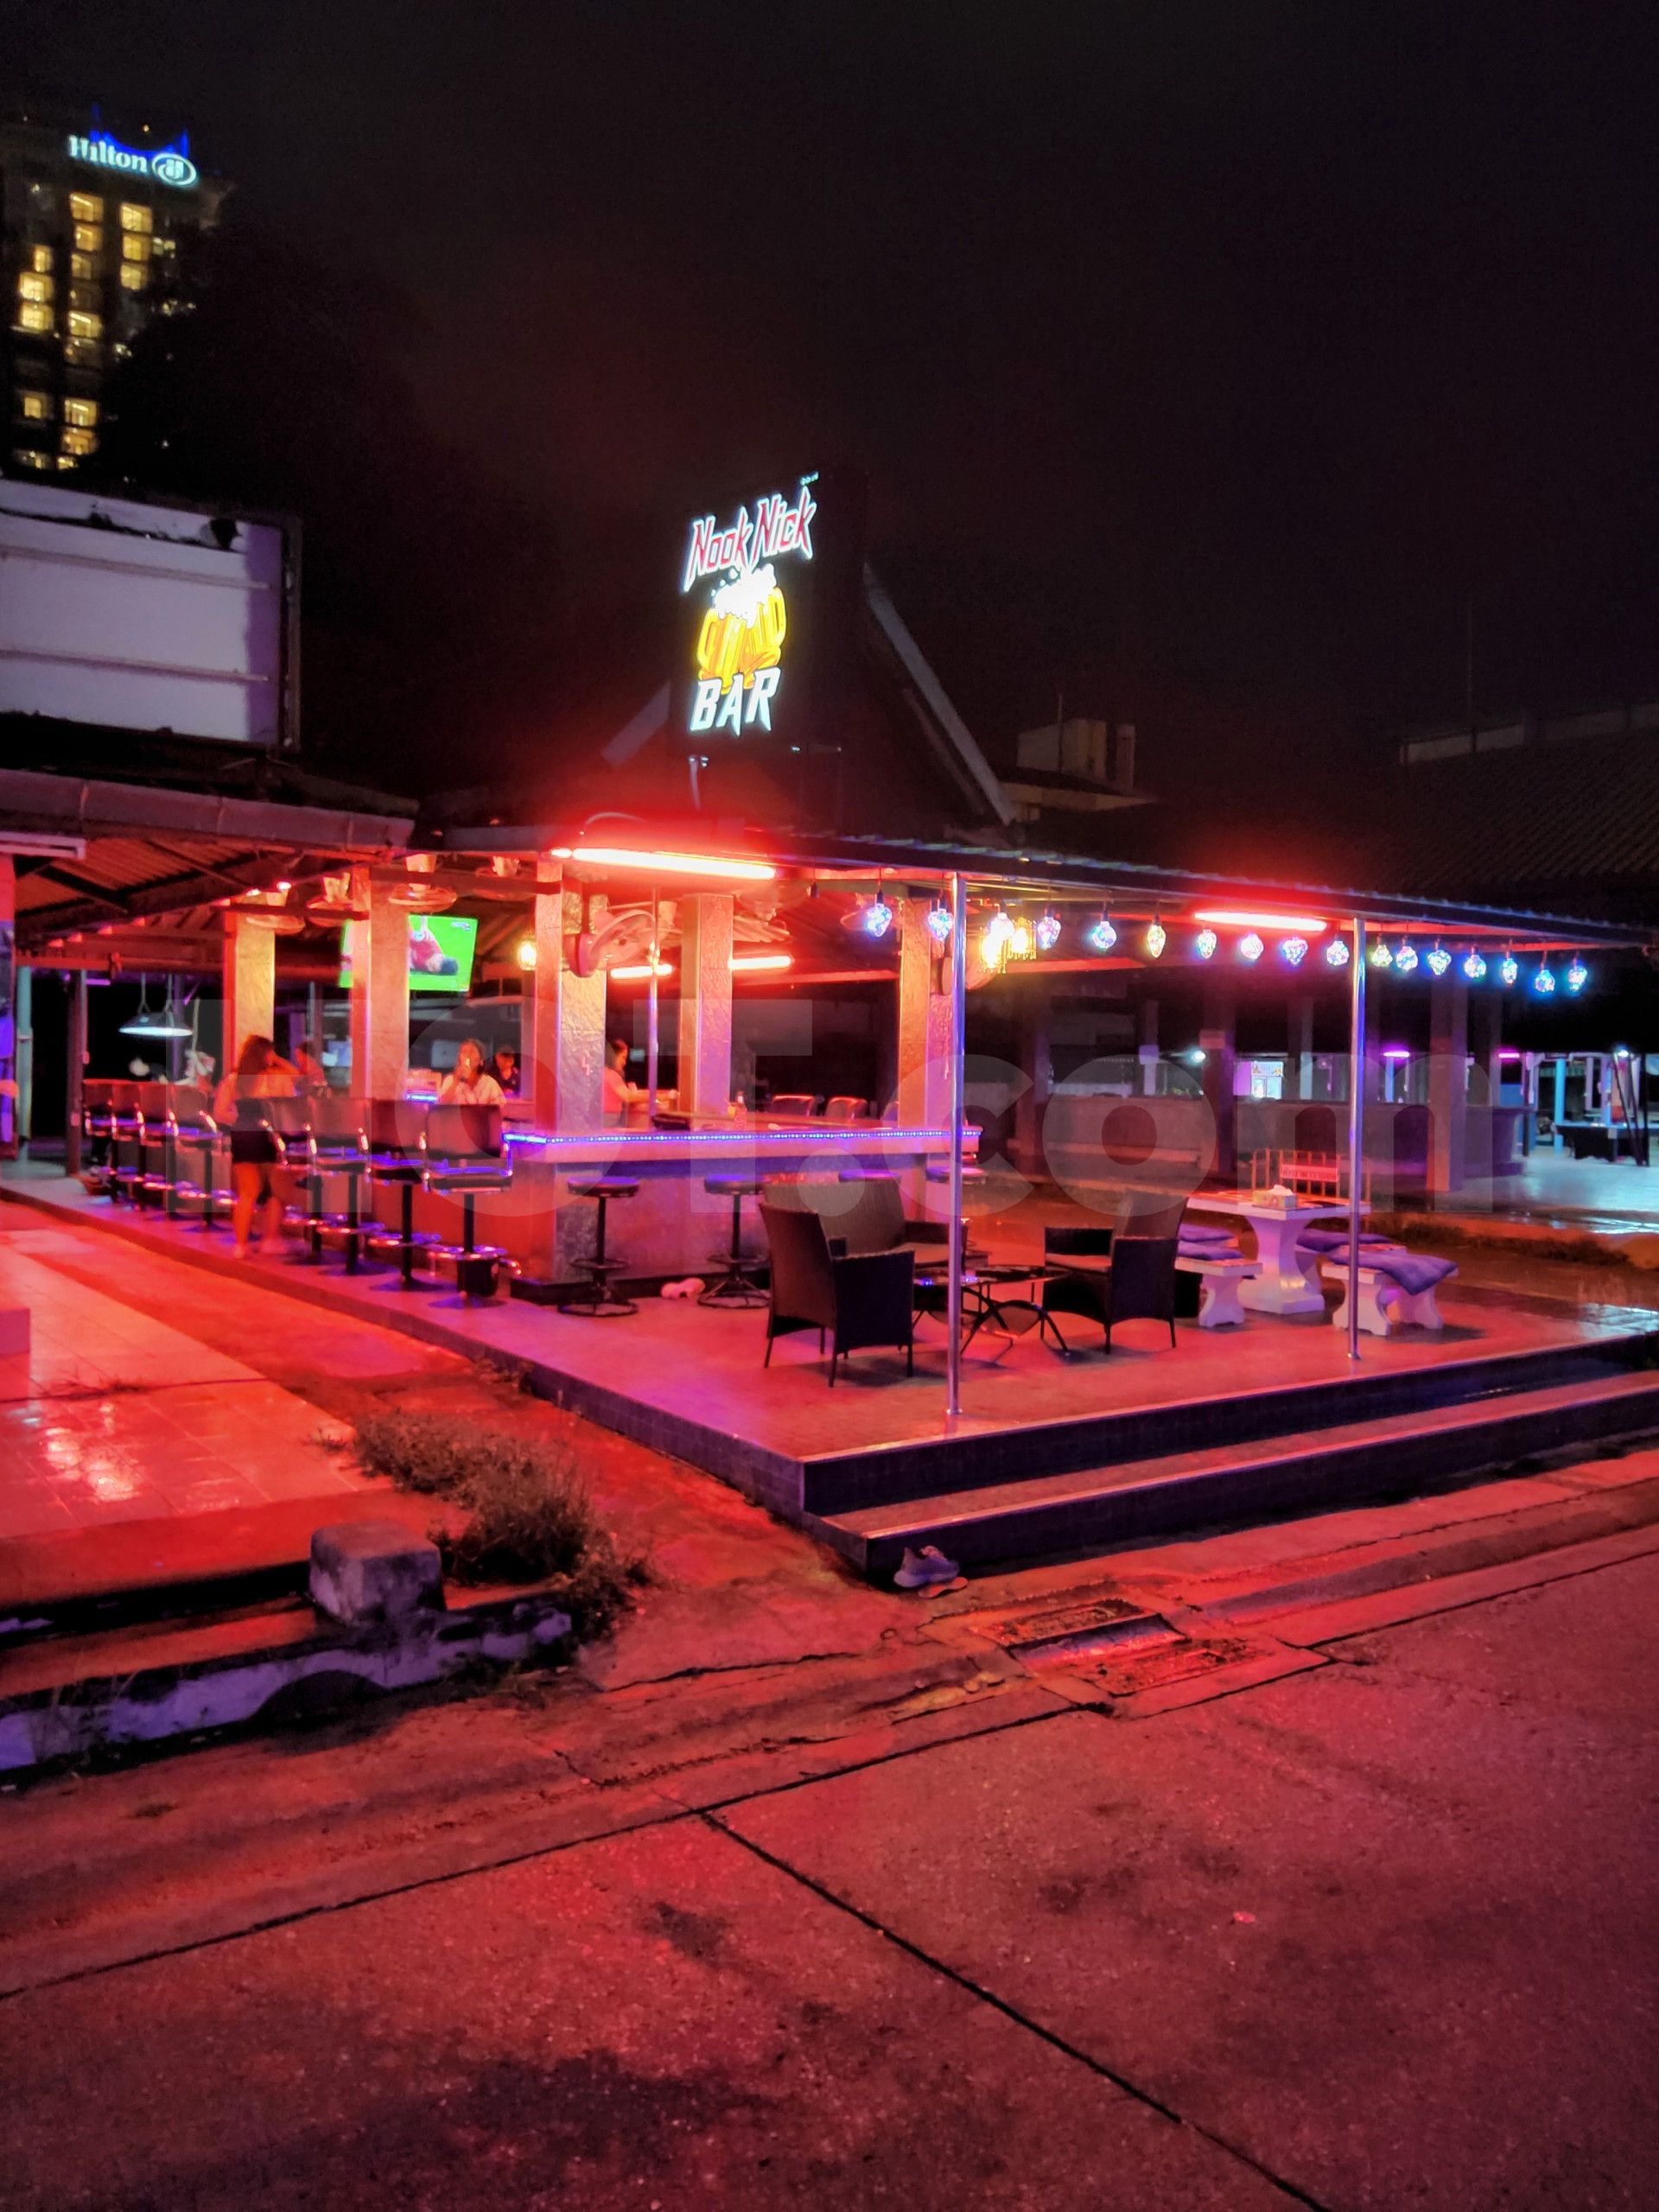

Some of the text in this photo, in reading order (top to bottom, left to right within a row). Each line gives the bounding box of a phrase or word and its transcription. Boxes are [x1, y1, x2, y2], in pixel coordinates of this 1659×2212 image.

[68, 134, 149, 174] Hilton
[682, 485, 817, 594] Nook Nick
[690, 666, 781, 737] BAR
